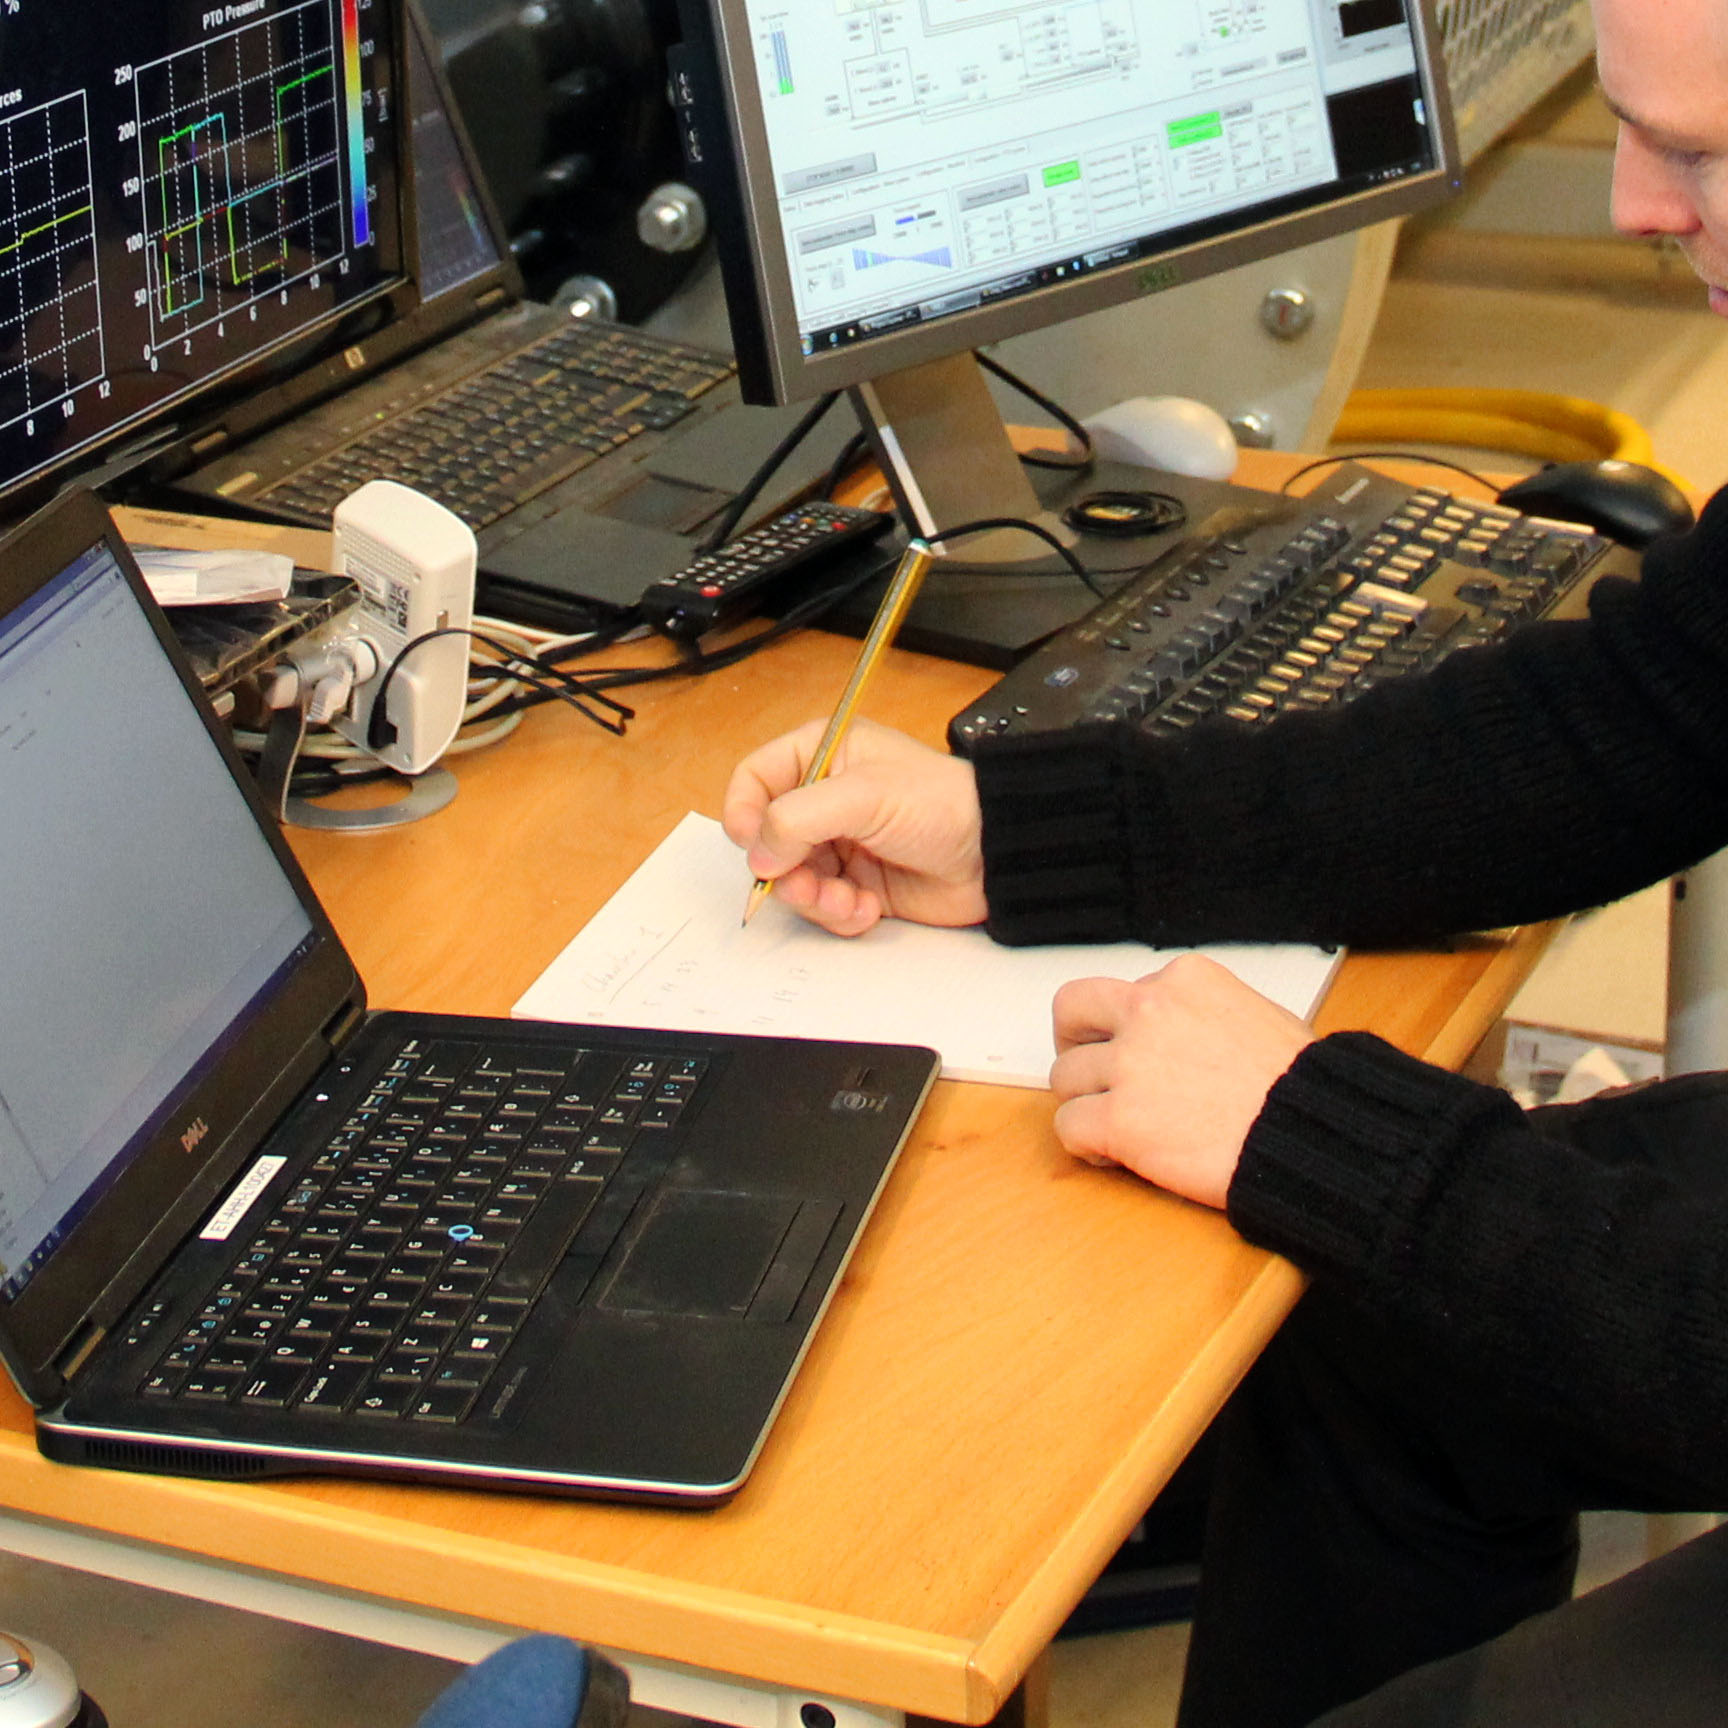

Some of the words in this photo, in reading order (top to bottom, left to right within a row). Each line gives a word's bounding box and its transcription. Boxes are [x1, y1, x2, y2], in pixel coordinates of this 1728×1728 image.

[202, 10, 223, 31] PTO
[114, 64, 133, 86] 250
[118, 120, 136, 142] 200
[122, 176, 139, 197] 150
[126, 232, 143, 253] 100
[134, 287, 146, 306] 50
[99, 380, 110, 400] 12
[62, 399, 74, 418] 10
[27, 419, 34, 437] 8
